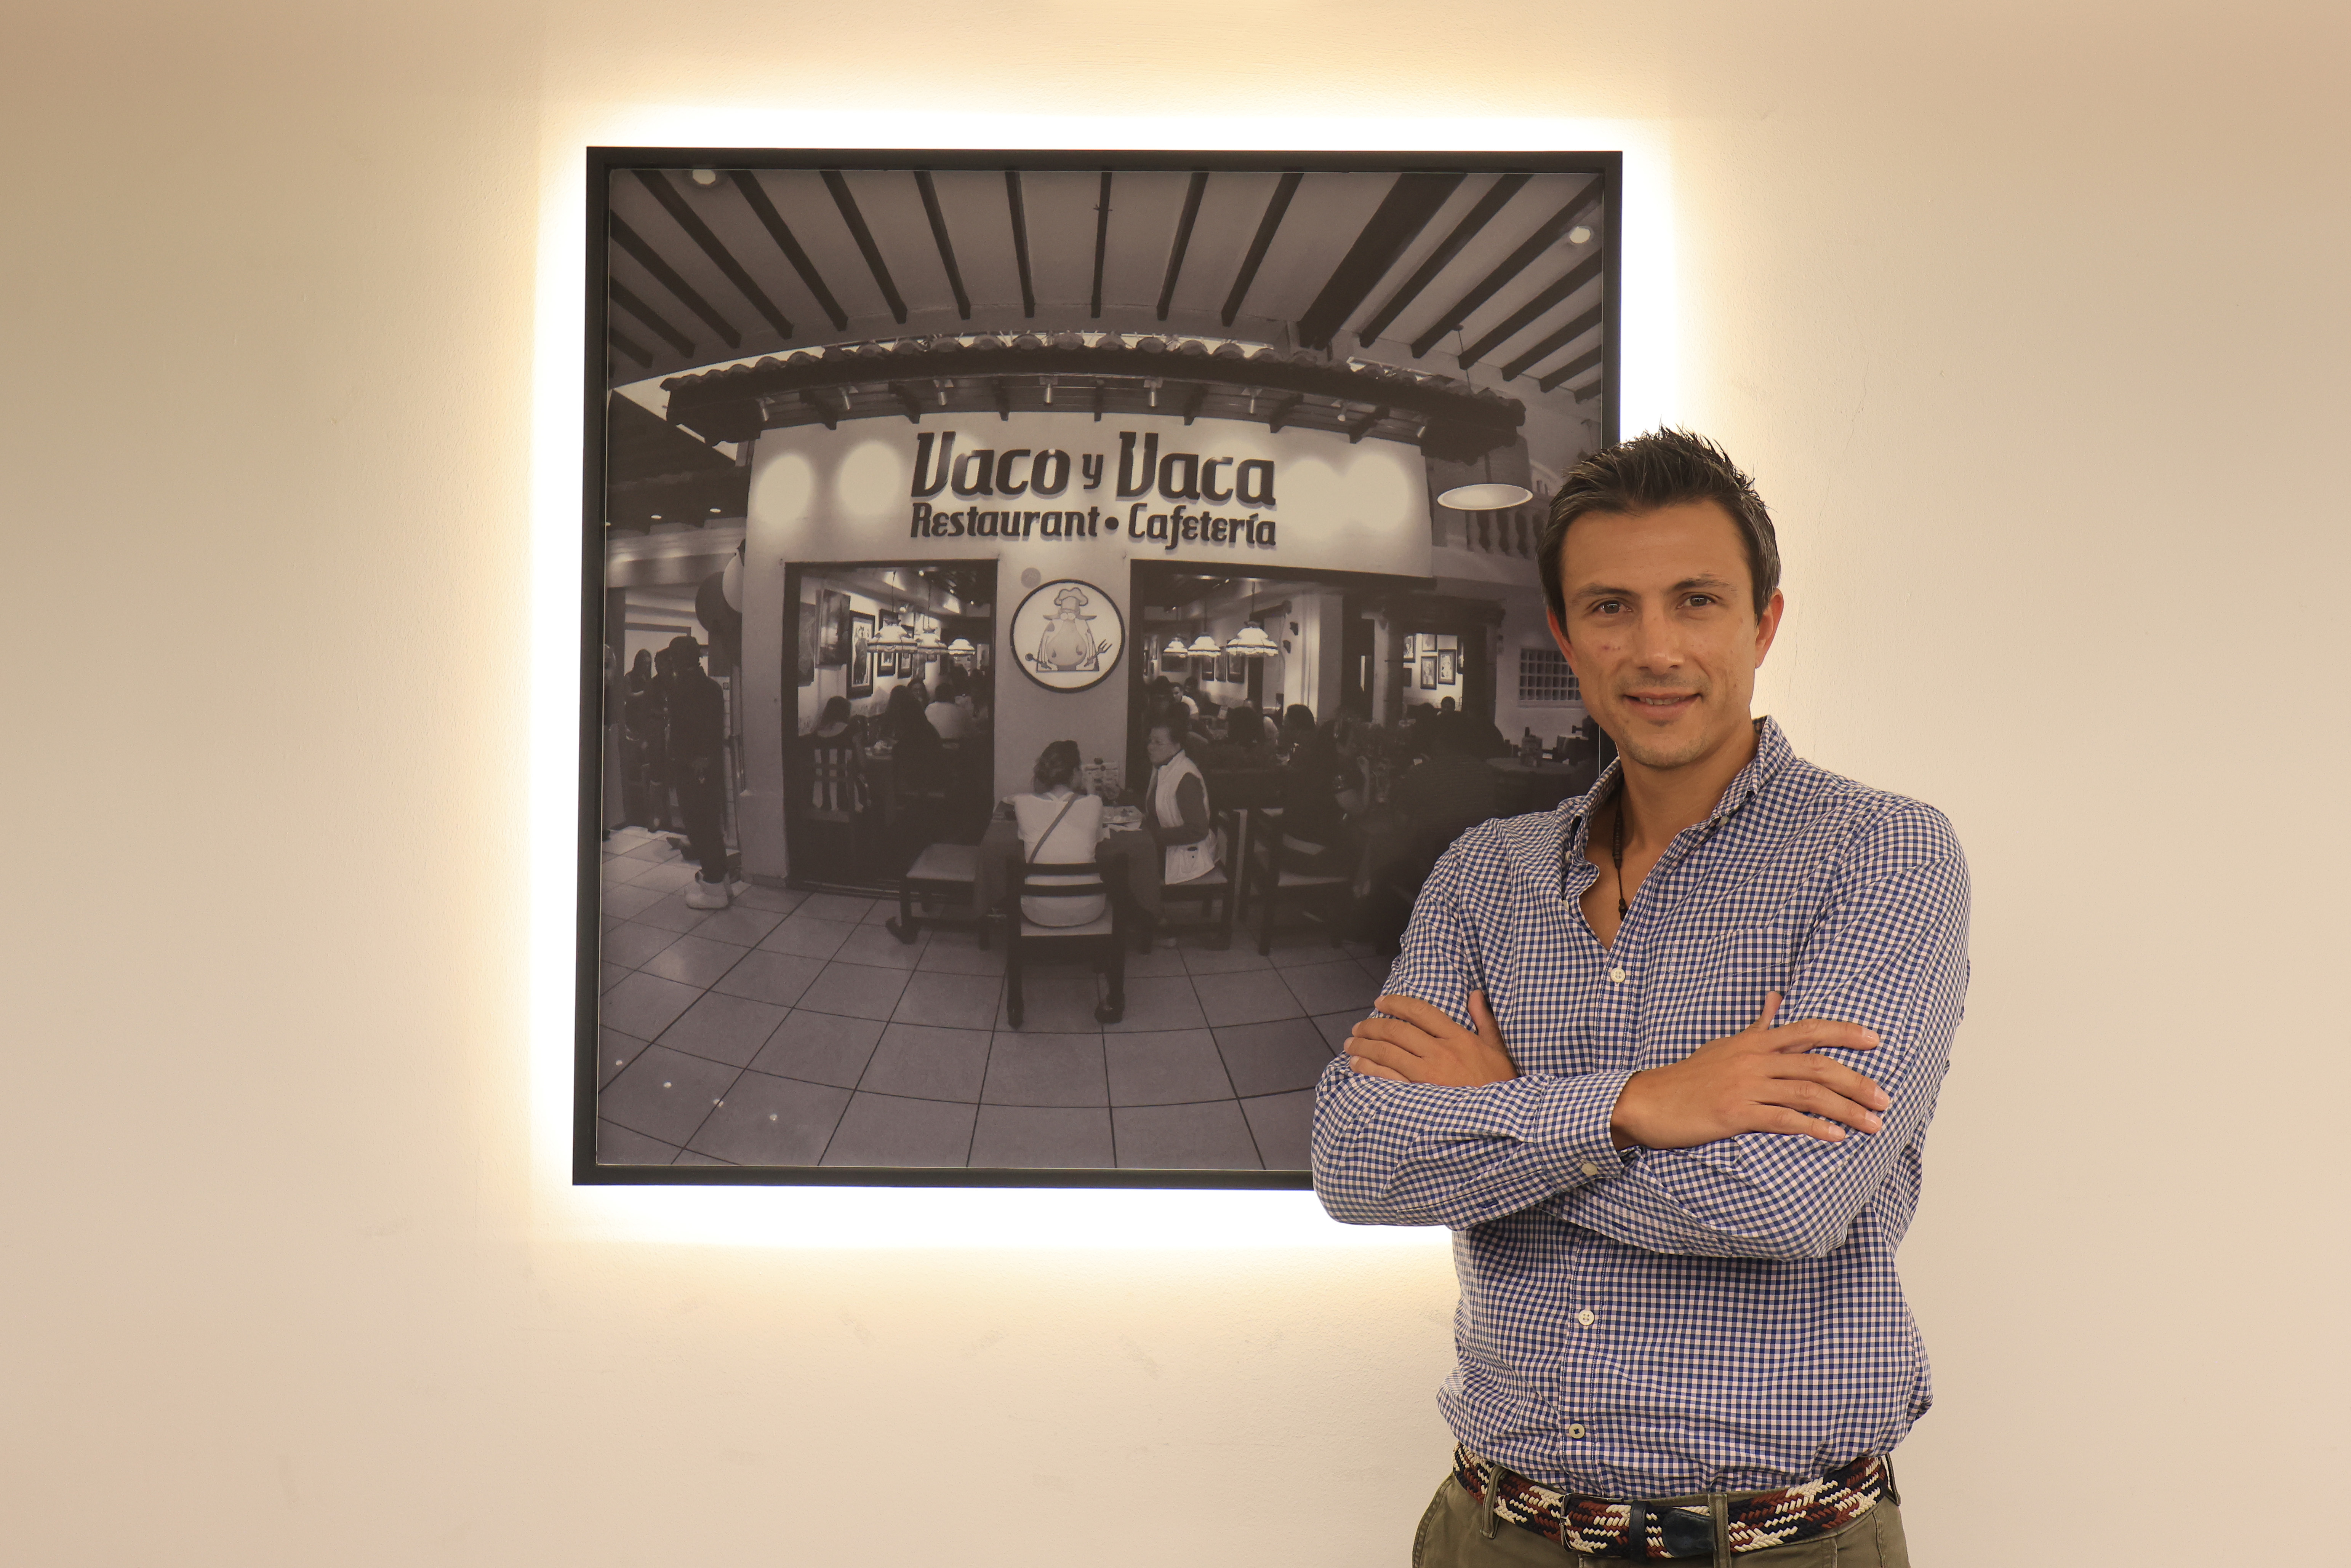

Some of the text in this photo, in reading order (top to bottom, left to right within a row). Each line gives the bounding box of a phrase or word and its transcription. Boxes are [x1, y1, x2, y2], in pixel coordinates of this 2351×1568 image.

[911, 431, 1276, 506] Vaco y Vaca
[911, 502, 1277, 550] Restaurant Cafetería
